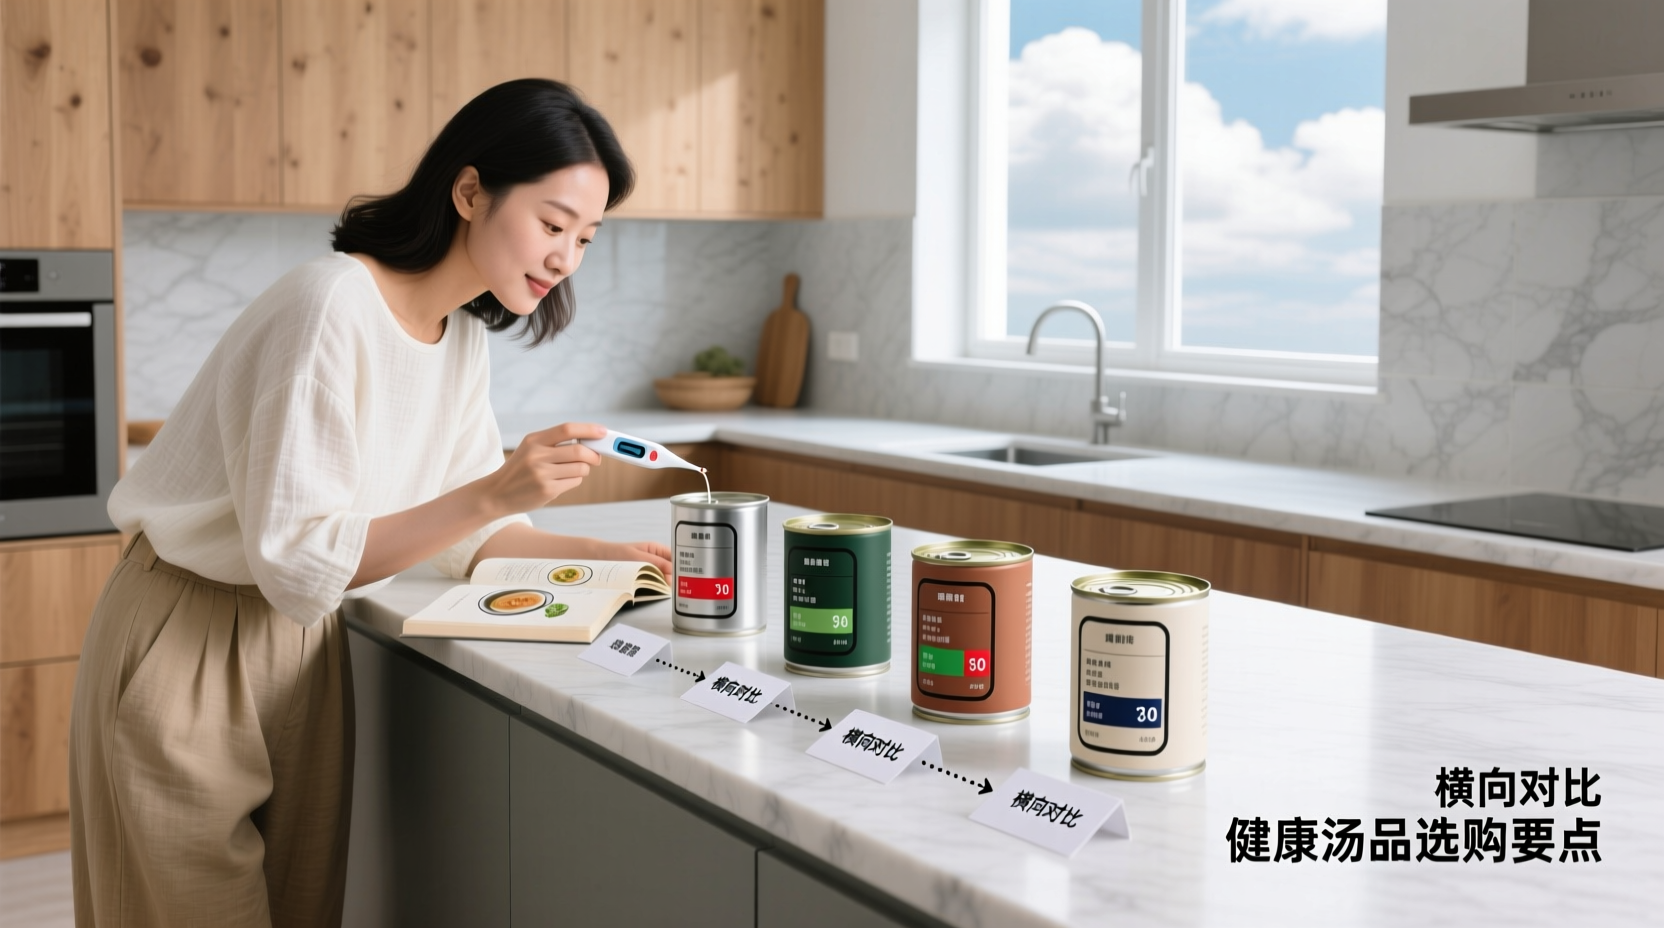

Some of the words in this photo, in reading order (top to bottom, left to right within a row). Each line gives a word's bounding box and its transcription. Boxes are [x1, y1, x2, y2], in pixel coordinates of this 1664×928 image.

[711, 676, 763, 704] 横向对比
[842, 727, 905, 762] 横向对比
[1010, 789, 1084, 828] 横向对比
